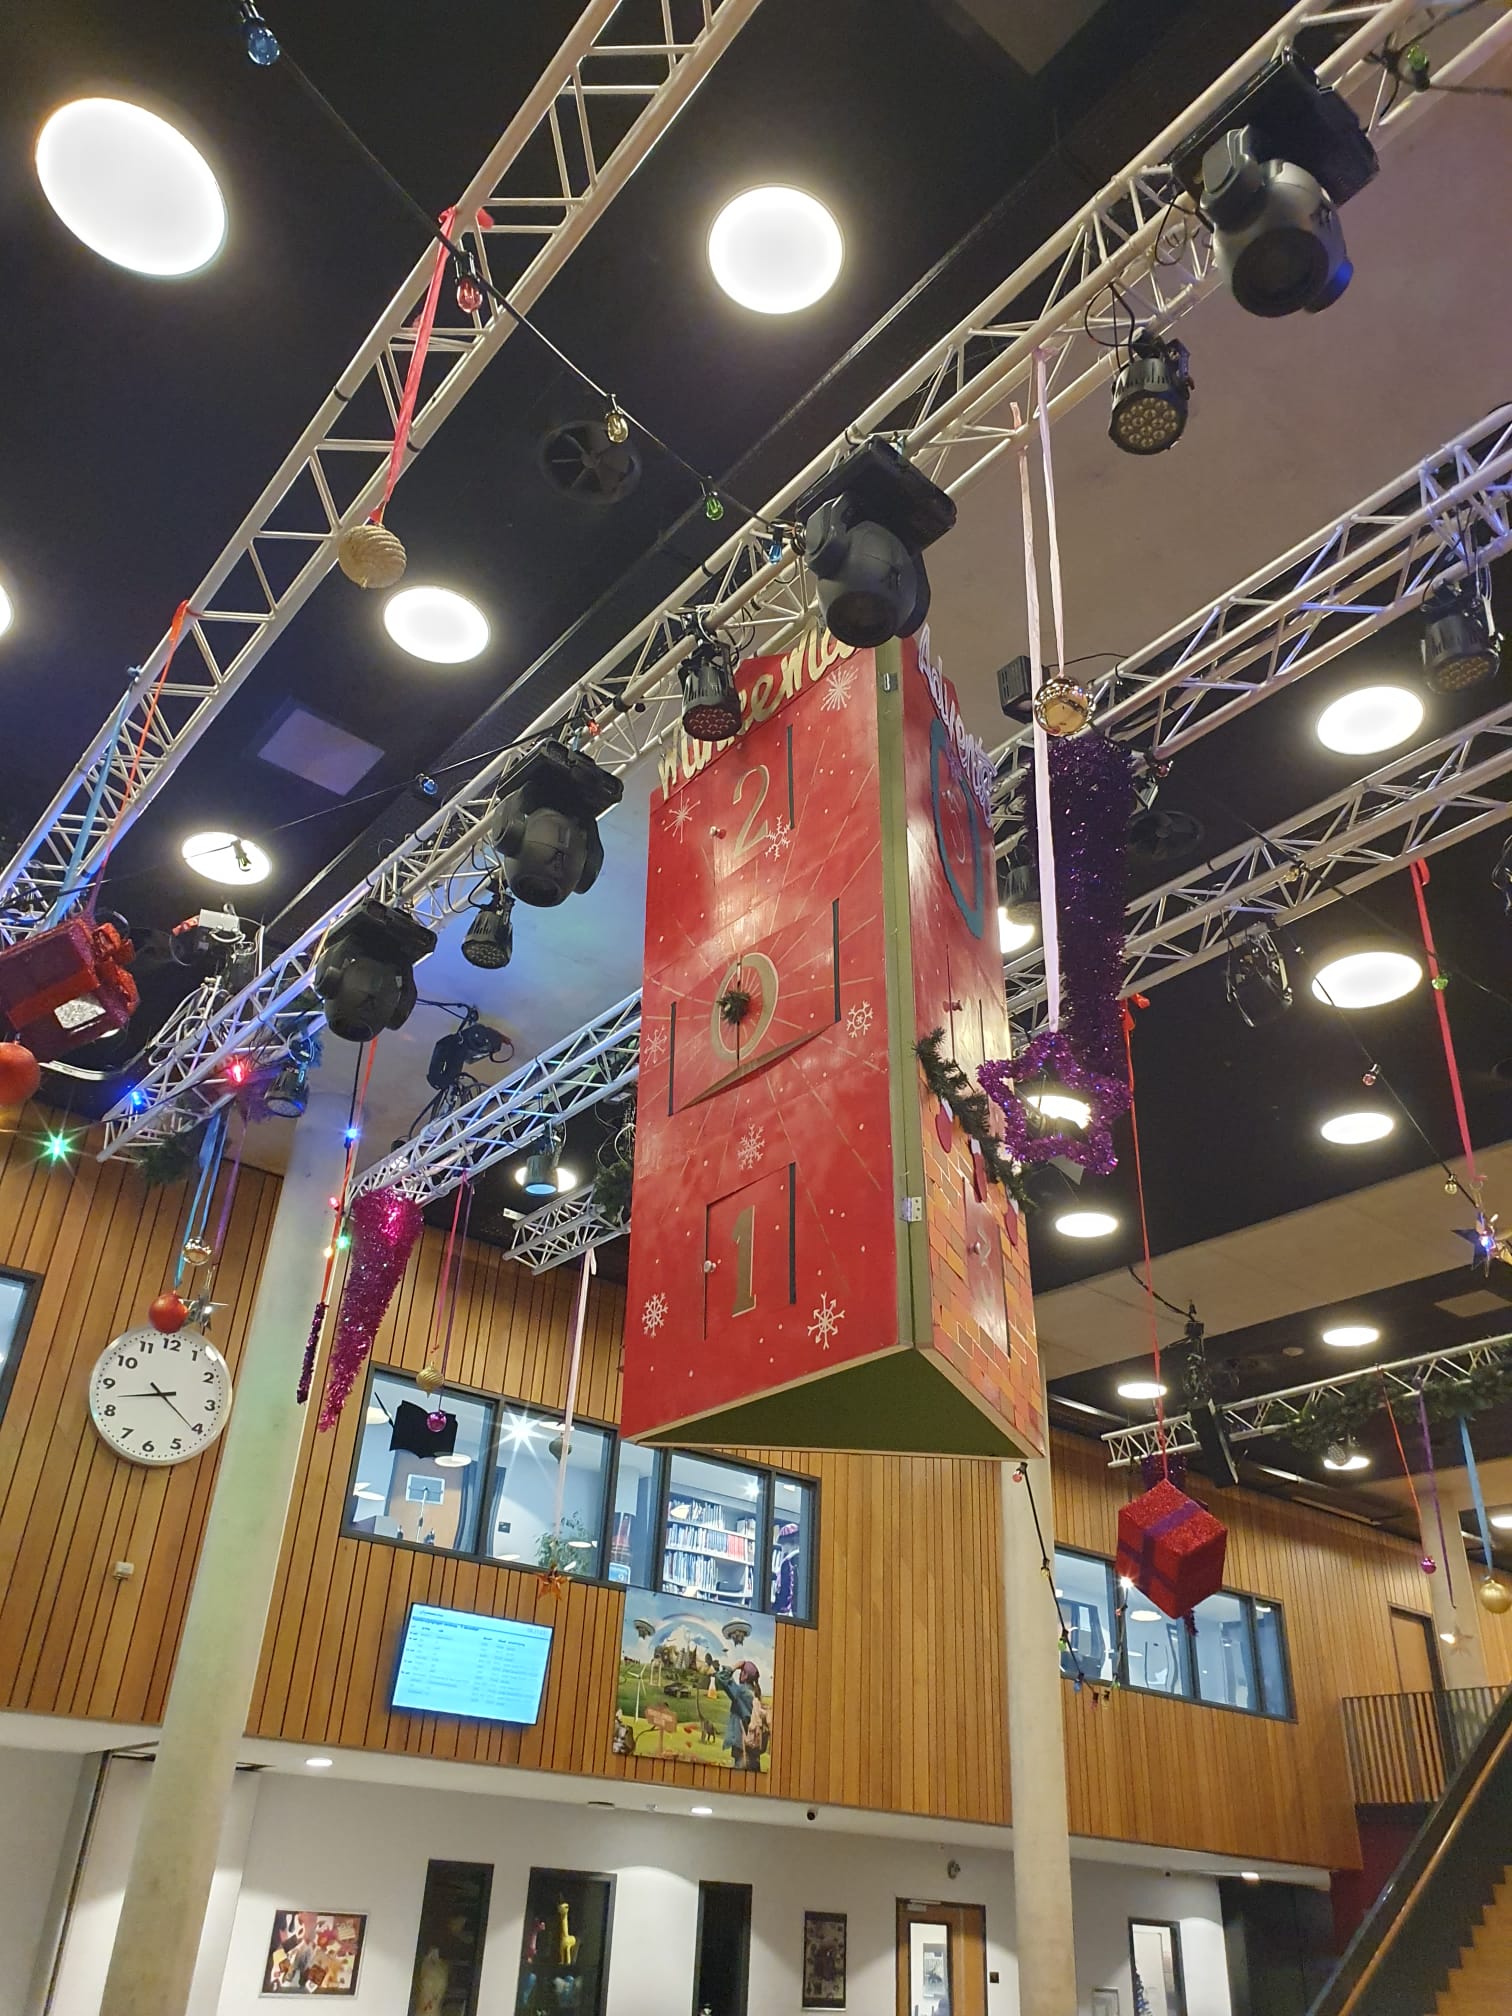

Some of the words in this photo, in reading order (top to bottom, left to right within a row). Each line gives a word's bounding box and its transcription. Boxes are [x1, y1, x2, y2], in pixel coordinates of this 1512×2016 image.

[732, 764, 769, 858] 2
[731, 1204, 757, 1318] 1
[139, 1341, 154, 1354] 11
[163, 1338, 182, 1352] 12
[117, 1355, 138, 1369] 10
[191, 1350, 198, 1361] 1
[102, 1377, 116, 1389] 9
[203, 1371, 215, 1384] 2
[104, 1404, 116, 1417] 8
[204, 1400, 216, 1411] 3
[121, 1427, 135, 1439] 7
[191, 1423, 203, 1436] 4
[142, 1440, 155, 1452] 6
[170, 1438, 182, 1450] 5
